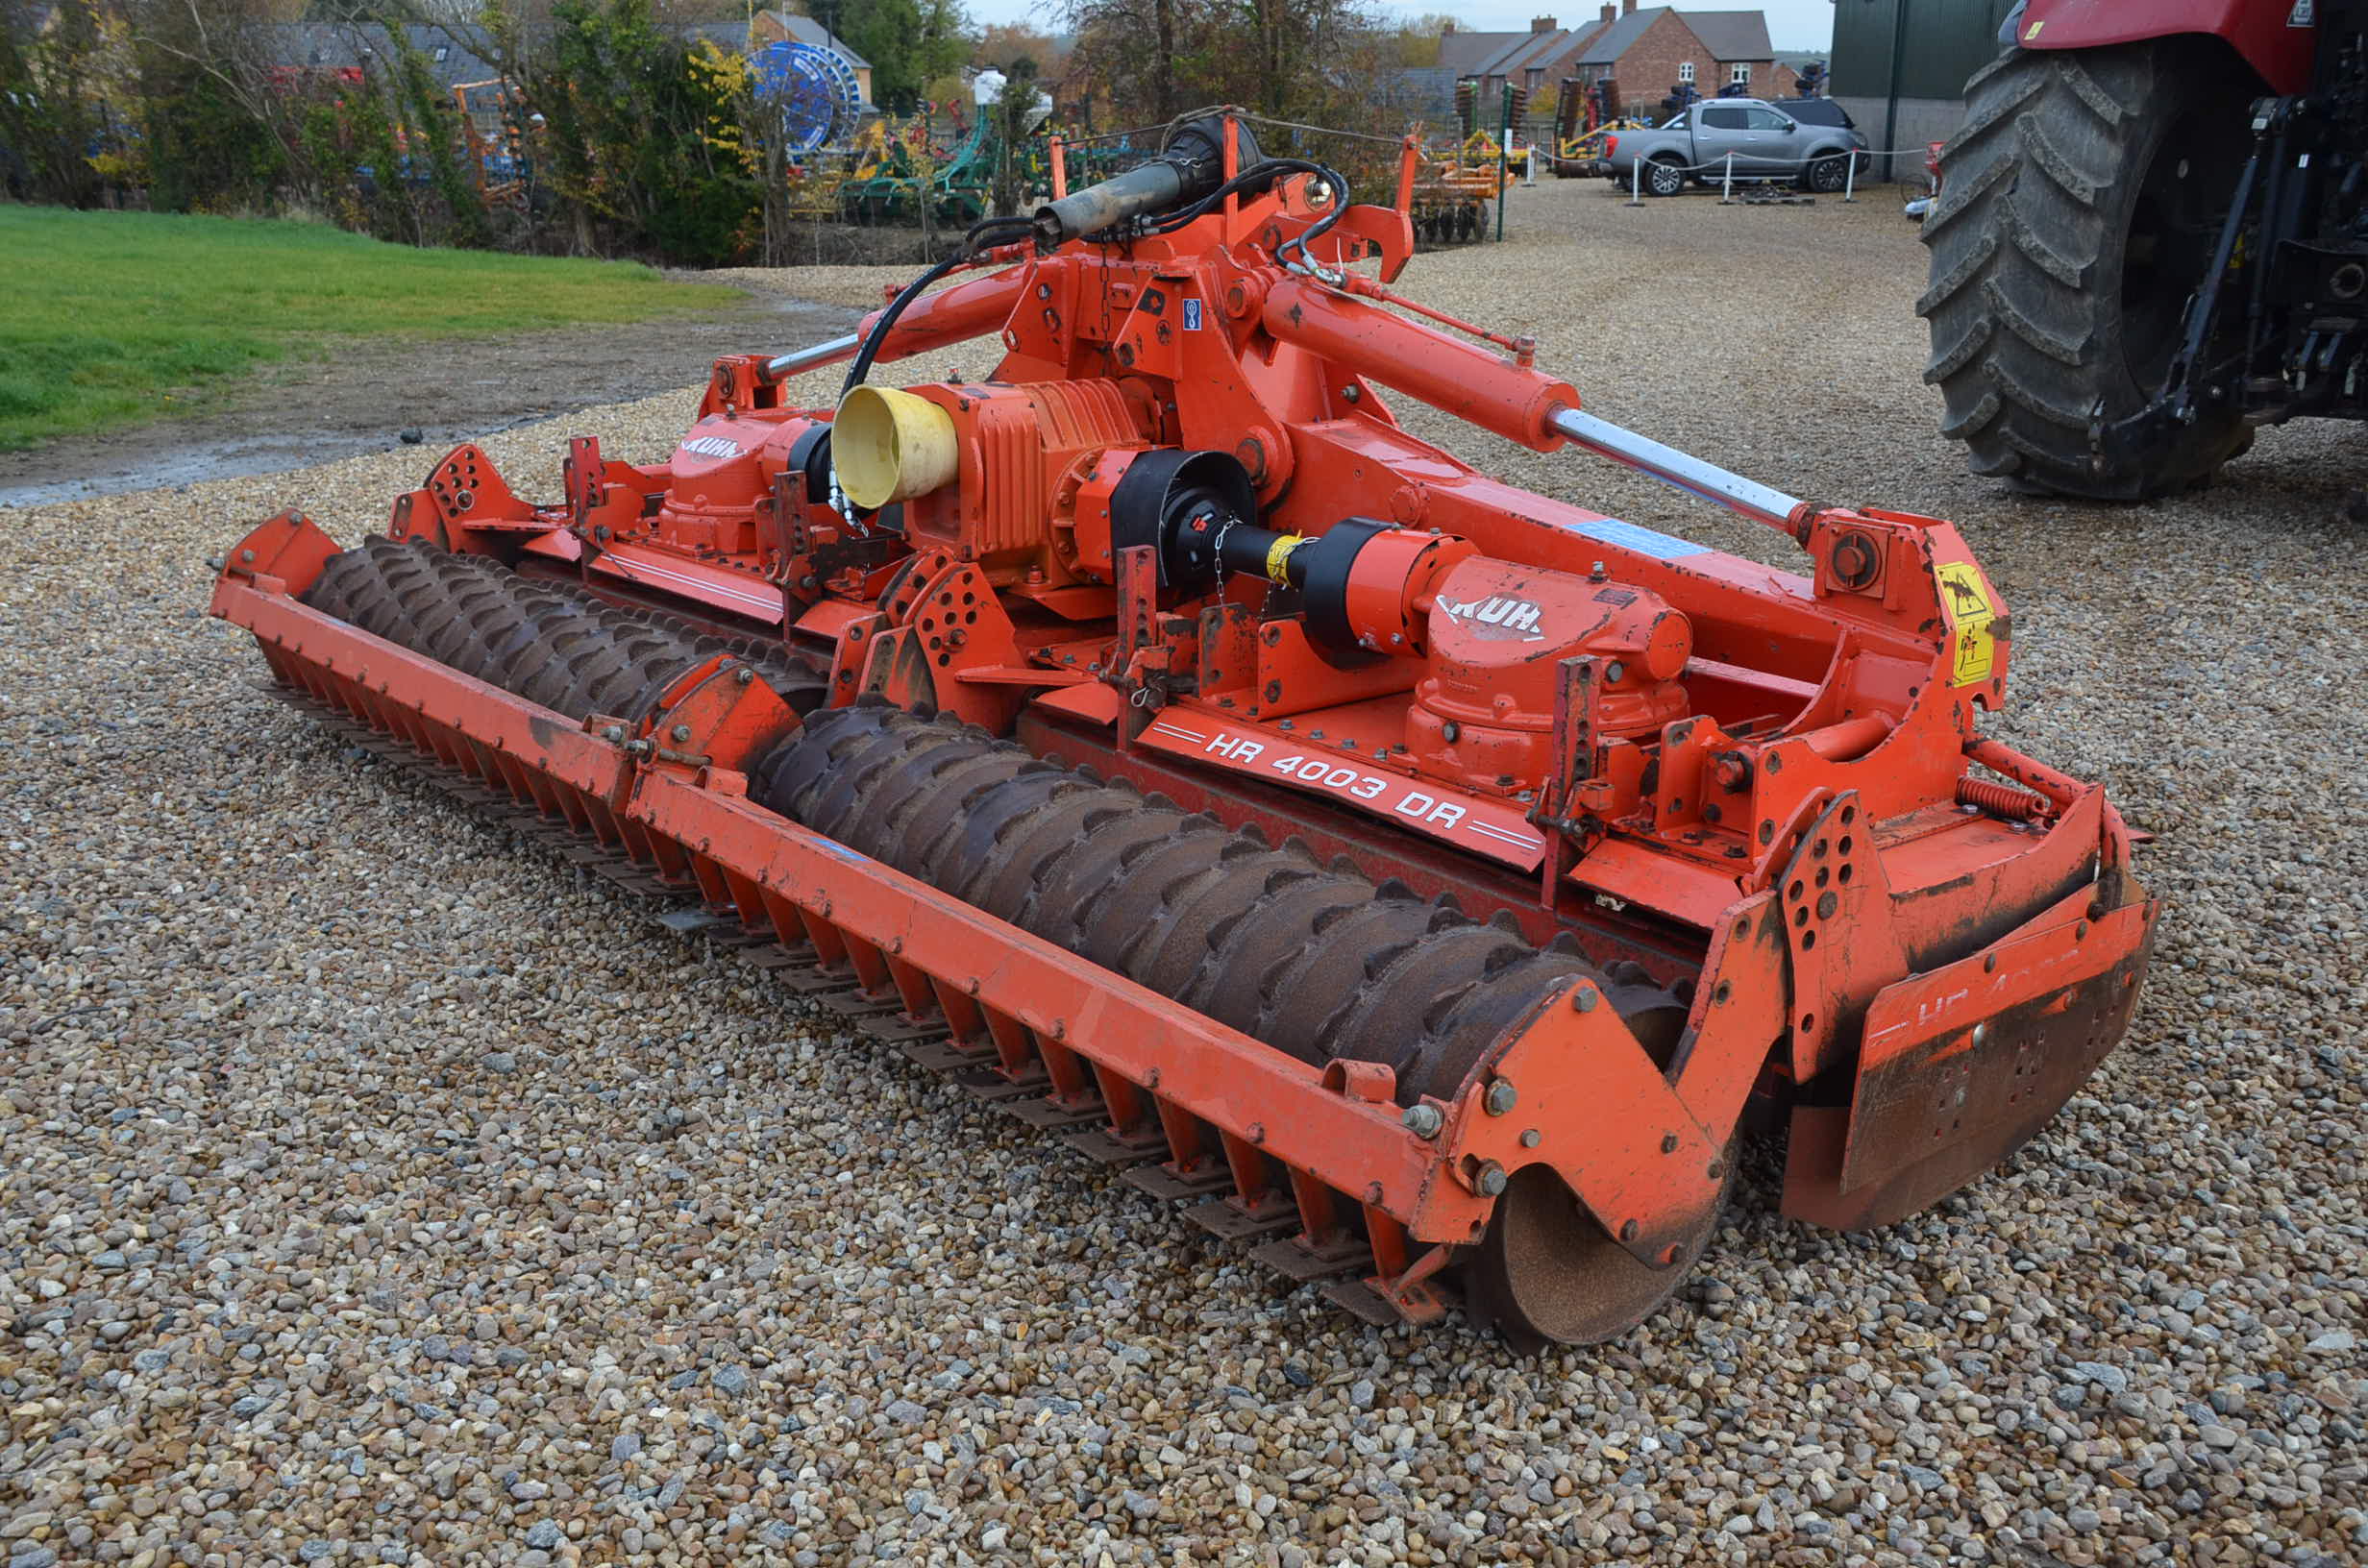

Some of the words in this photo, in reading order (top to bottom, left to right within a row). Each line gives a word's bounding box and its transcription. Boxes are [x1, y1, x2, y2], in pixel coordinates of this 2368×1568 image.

[1444, 595, 1542, 634] KUH
[1204, 733, 1265, 764] HR
[1270, 755, 1389, 799] 4003
[1394, 791, 1468, 830] DR
